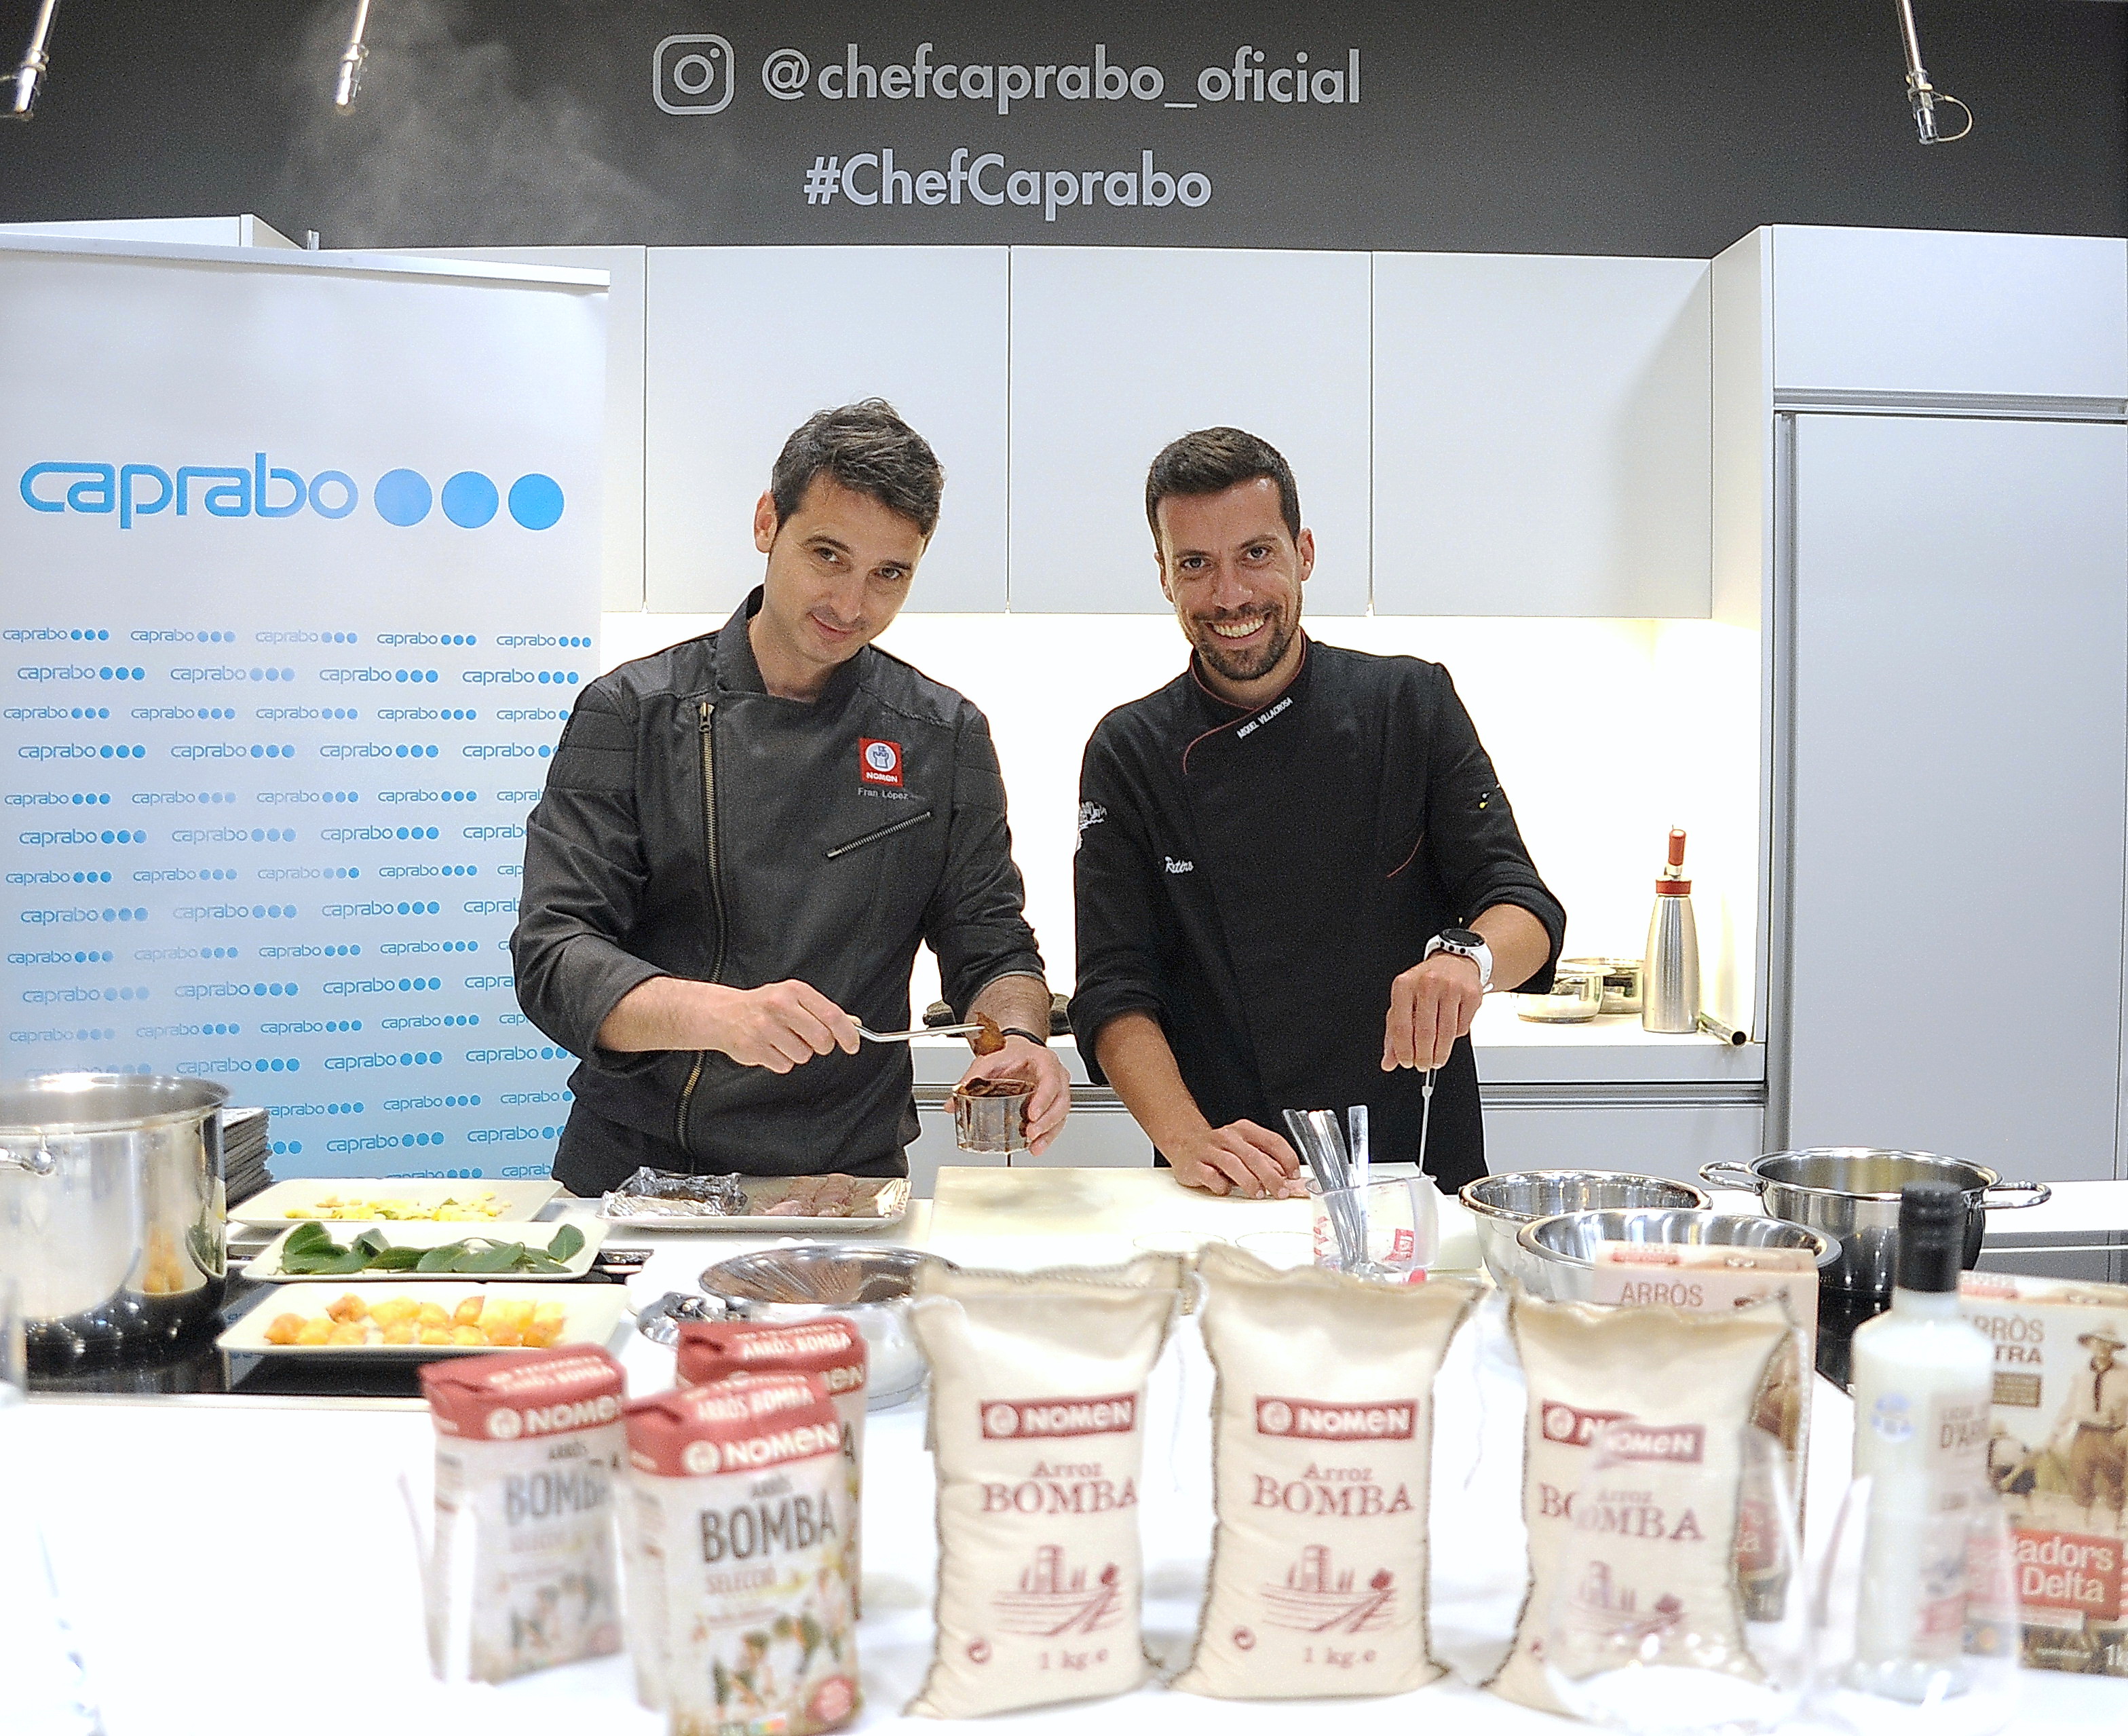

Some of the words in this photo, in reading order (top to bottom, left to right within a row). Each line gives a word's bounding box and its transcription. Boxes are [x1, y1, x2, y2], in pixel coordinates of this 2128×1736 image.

[761, 43, 1361, 115] @chefcaprabo_oficial
[803, 147, 1212, 222] #ChefCaprabo
[19, 451, 360, 531] caprabo
[3, 628, 67, 643] caprabo
[130, 630, 193, 643] caprabo
[377, 633, 438, 647] caprabo
[497, 633, 556, 647] caprabo
[18, 665, 95, 682] caprabo
[170, 666, 246, 683] caprabo
[320, 667, 392, 683] caprabo
[463, 668, 535, 685] caprabo
[3, 706, 68, 721] caprabo
[131, 706, 194, 721] caprabo
[256, 706, 318, 721] caprabo
[377, 707, 438, 721] caprabo
[497, 708, 556, 722] caprabo
[18, 743, 96, 761] caprabo
[171, 743, 246, 760] caprabo
[320, 742, 392, 759] caprabo
[463, 742, 535, 760] caprabo
[5, 793, 69, 807] caprabo
[132, 791, 195, 806] caprabo
[256, 790, 320, 805] caprabo
[378, 789, 438, 804] caprabo
[497, 789, 542, 803] capra
[857, 787, 879, 798] Fran
[19, 829, 97, 847] caprabo
[172, 827, 248, 844] caprabo
[322, 825, 393, 843] caprabo
[463, 824, 527, 841] caprab
[5, 871, 70, 886] caprabo
[132, 868, 196, 884] caprabo
[379, 865, 438, 879] caprabo
[20, 908, 98, 926] caprabo
[173, 904, 248, 922] caprabo
[322, 901, 394, 919] caprabo
[463, 898, 520, 915] capra
[7, 951, 71, 966] caprabo
[259, 945, 322, 959] caprabo
[380, 941, 440, 956] caprabo
[22, 987, 100, 1005] caprabo
[175, 981, 250, 1000] caprabo
[323, 978, 395, 996] caprabo
[465, 977, 513, 991] capra
[261, 1021, 323, 1036] caprabo
[381, 1015, 441, 1030] caprabo
[176, 1057, 252, 1076] caprabo
[324, 1053, 396, 1072] caprabo
[466, 1046, 537, 1064] caprabo
[383, 1096, 442, 1112] caprabo
[500, 1091, 559, 1106] caprabo
[326, 1135, 398, 1154] caprabo
[468, 1126, 539, 1144] caprabo
[502, 1164, 551, 1177] caprab
[1971, 1312, 2045, 1344] RRÒS
[1023, 1400, 1131, 1431] NOMEN
[1297, 1407, 1410, 1433] NOMEN
[723, 1421, 841, 1467] NOMEN
[1302, 1461, 1373, 1482] Arroz
[981, 1476, 1139, 1514] BOMBA
[1251, 1473, 1416, 1517] BOMBA
[700, 1490, 837, 1564] BOMBA
[2022, 1566, 2105, 1604] Delta
